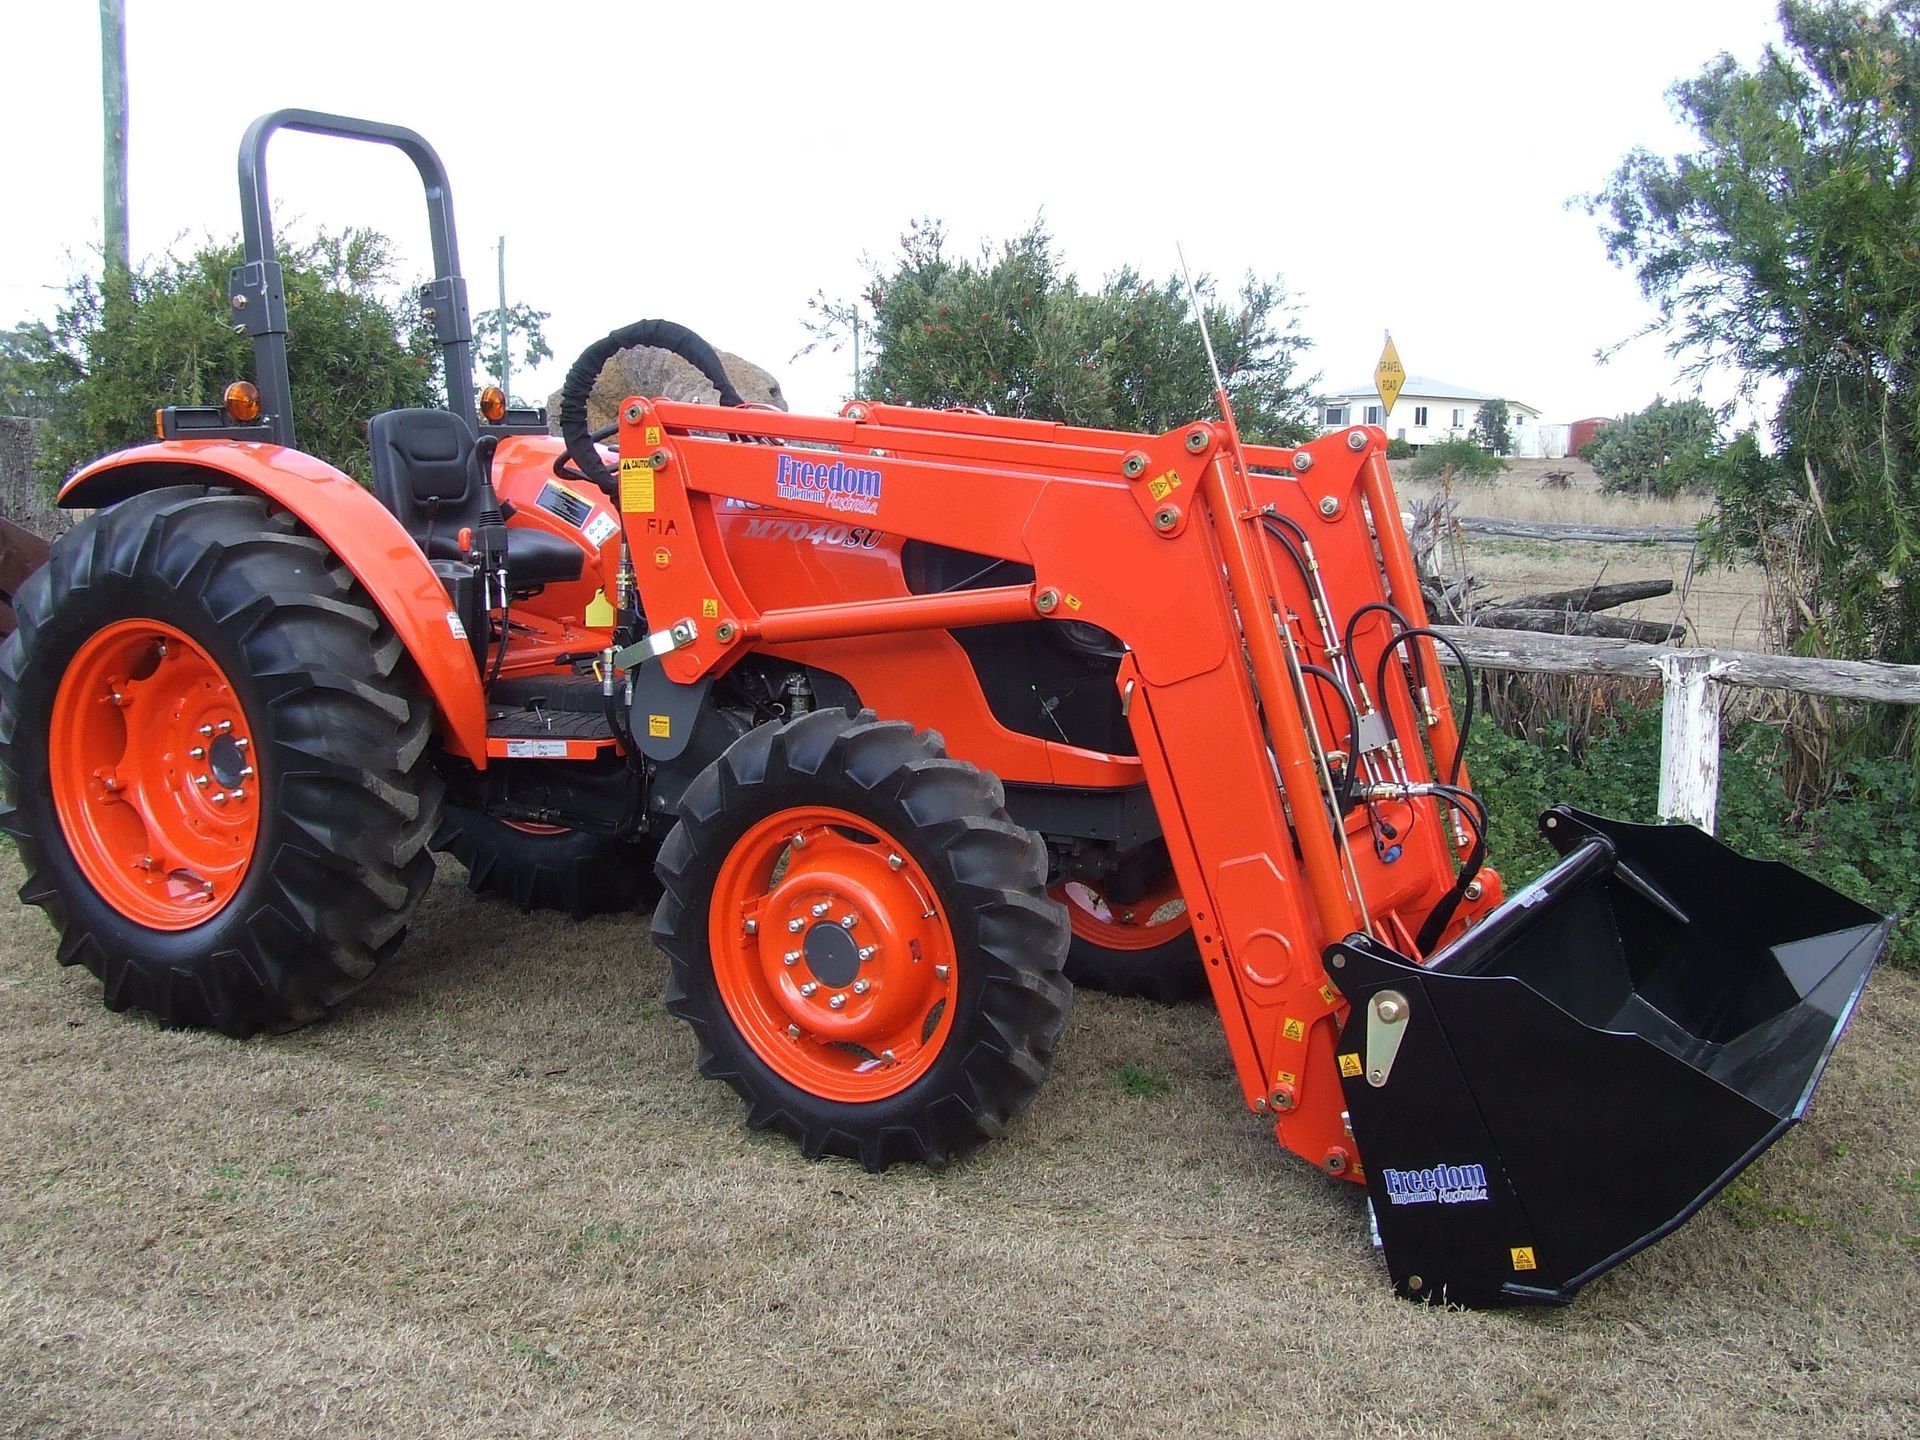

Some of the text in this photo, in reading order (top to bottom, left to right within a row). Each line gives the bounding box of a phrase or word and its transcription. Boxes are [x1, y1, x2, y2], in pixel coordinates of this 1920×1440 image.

[1380, 361, 1401, 373] GRAVEL
[1382, 379, 1397, 391] ROAD
[631, 459, 650, 469] CAUTIO
[777, 454, 882, 500] Freedom
[777, 484, 826, 504] Implements
[826, 490, 879, 516] Australia
[647, 518, 678, 536] FIA
[741, 518, 884, 550] M7040SU
[1383, 1163, 1487, 1195] Freedom
[1389, 1187, 1489, 1205] Implements Australia
